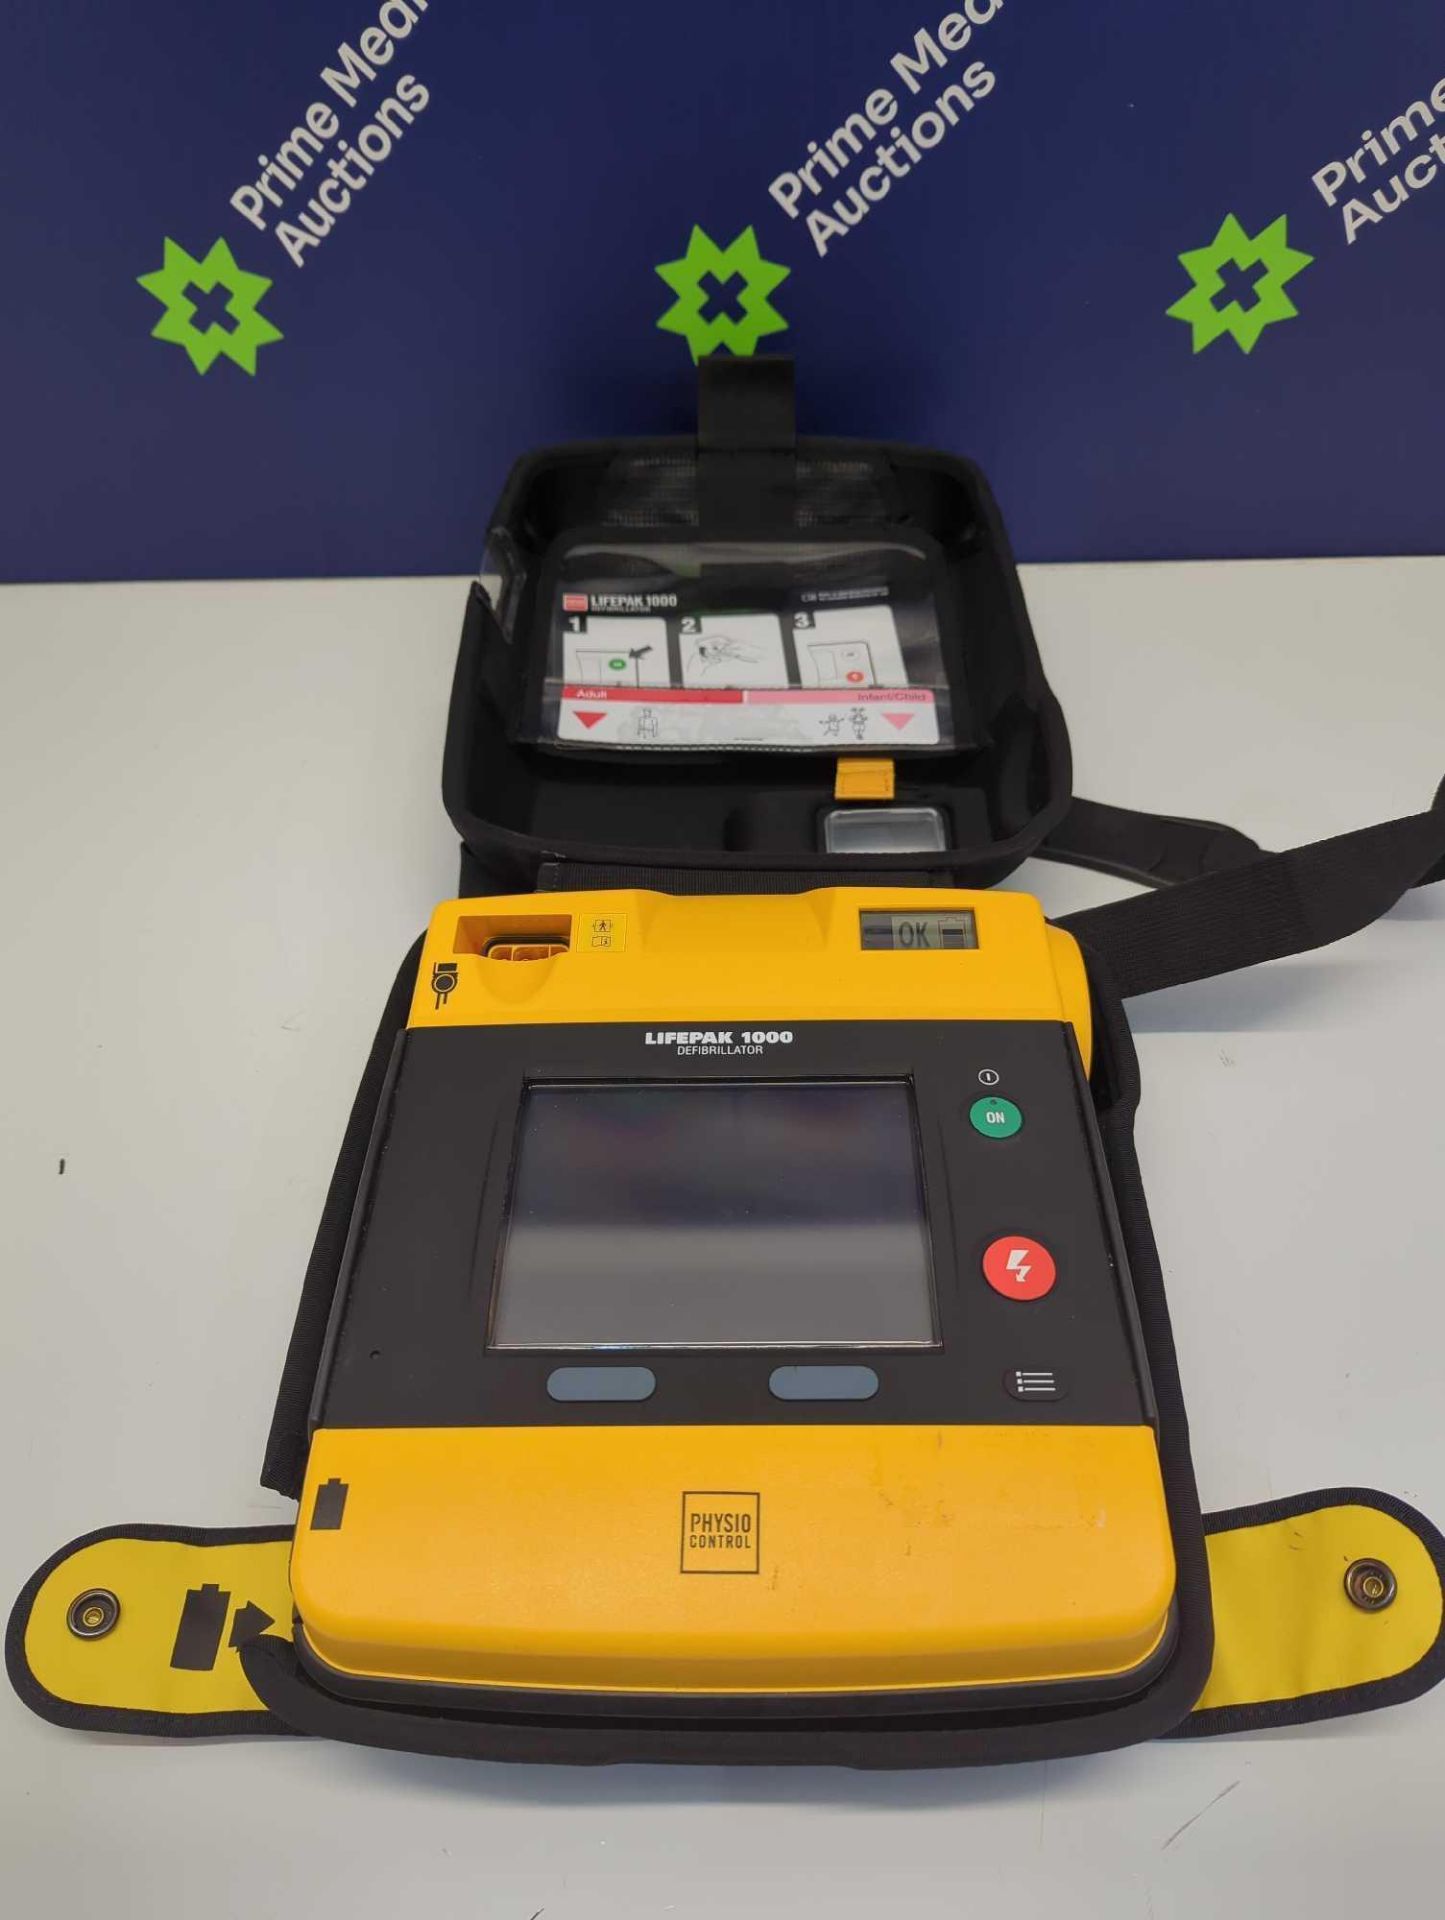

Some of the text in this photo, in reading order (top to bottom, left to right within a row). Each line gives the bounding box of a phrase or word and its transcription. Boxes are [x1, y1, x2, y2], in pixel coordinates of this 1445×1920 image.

[230, 0, 429, 231] Prime Med
[768, 87, 899, 219] Prime
[805, 61, 997, 258] Auctions
[274, 70, 431, 268] Auctions
[590, 594, 643, 607] LIFEPAK
[645, 592, 678, 607] 1000
[568, 616, 581, 632] 1
[681, 617, 696, 633] 2
[794, 612, 810, 628] 3
[898, 921, 931, 948] OK
[645, 1030, 794, 1045] LIFEPAK 1000
[677, 1045, 764, 1056] DEFIBRILLATOR
[986, 1111, 1006, 1124] ON
[690, 1513, 751, 1533] PHYSIO
[689, 1534, 751, 1549] CONTROL
